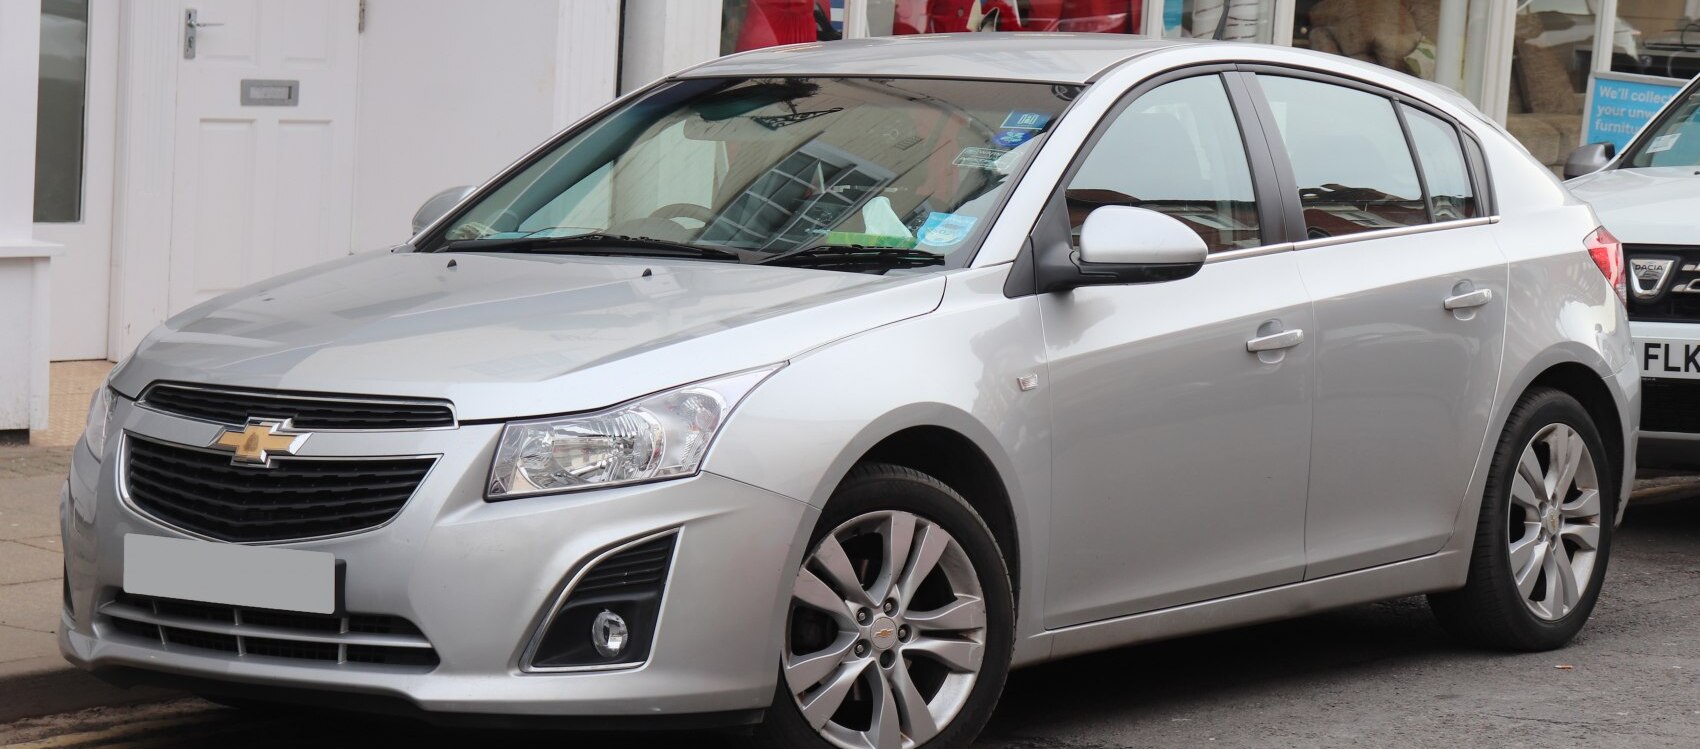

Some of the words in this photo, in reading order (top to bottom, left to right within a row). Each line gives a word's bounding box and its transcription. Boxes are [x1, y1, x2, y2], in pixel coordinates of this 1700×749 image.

[1600, 86, 1628, 99] We'll
[1597, 104, 1626, 116] your
[1644, 342, 1700, 373] FLK
